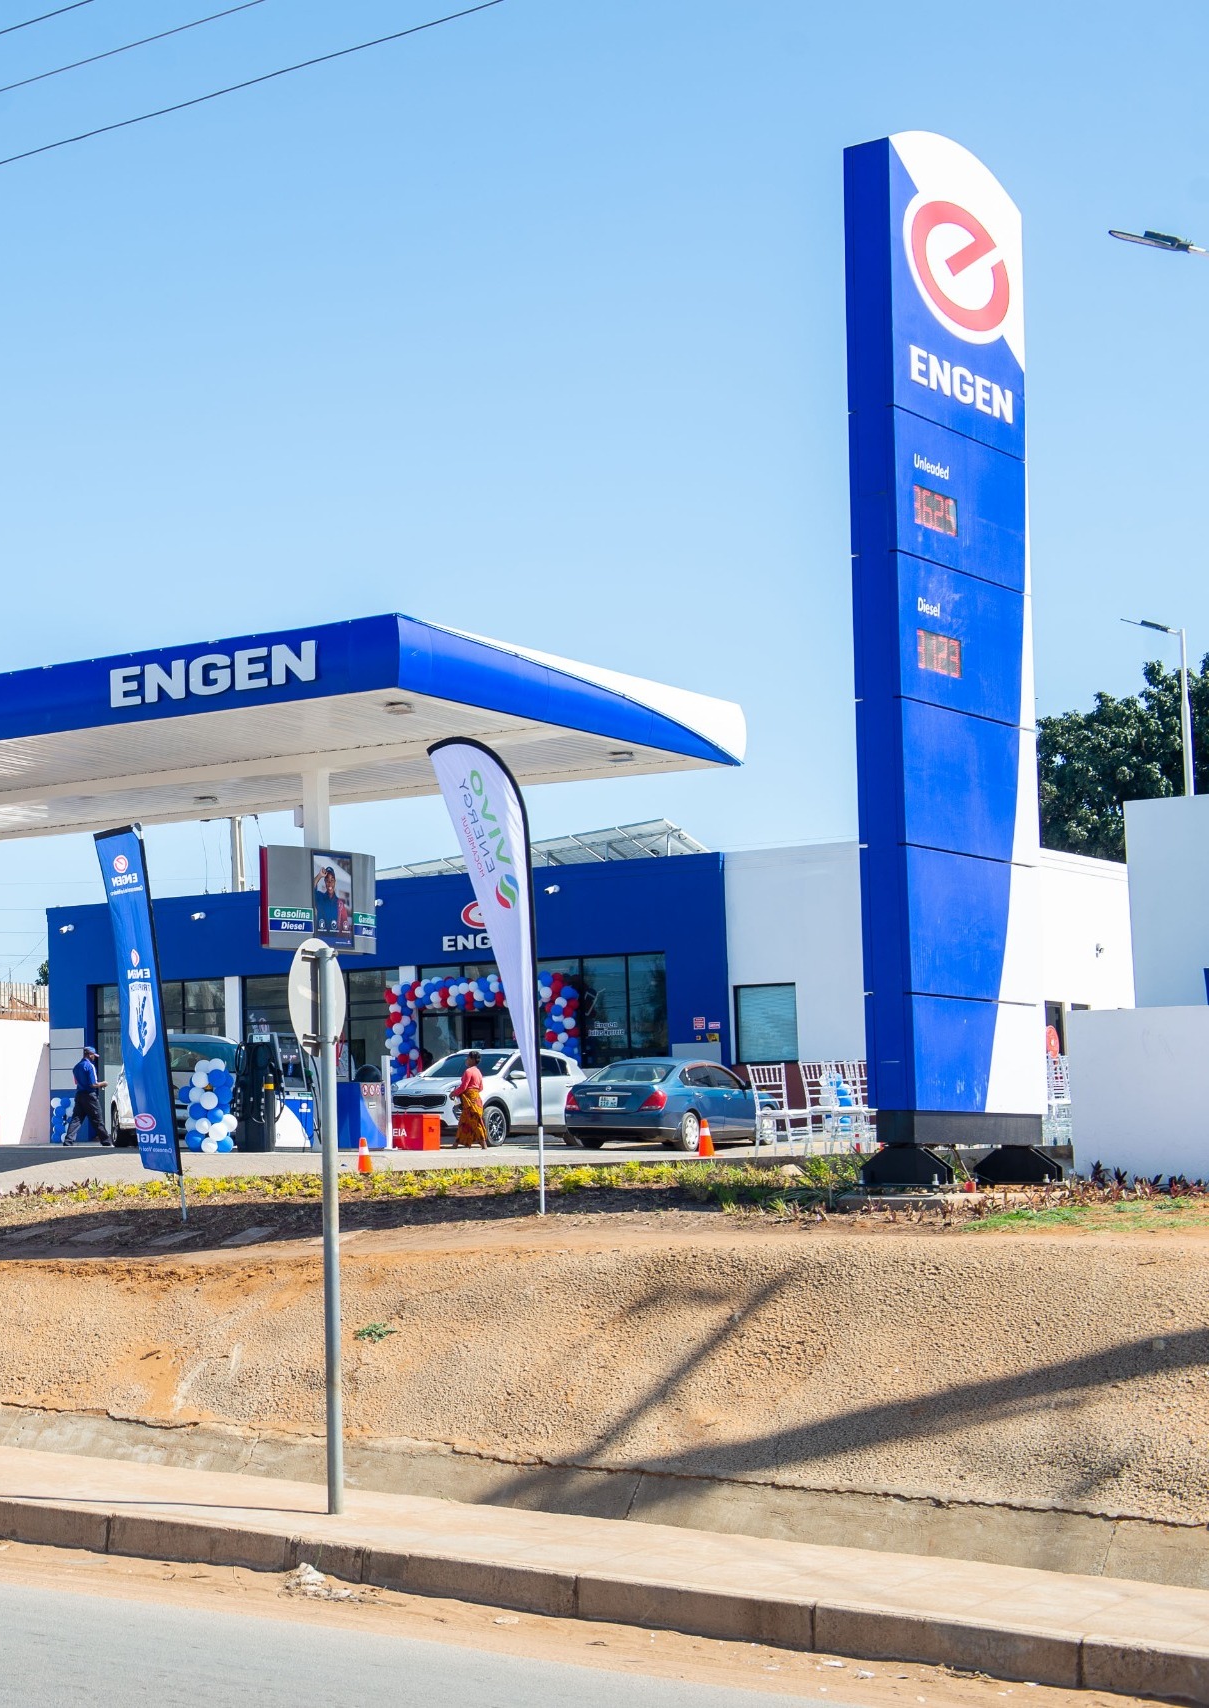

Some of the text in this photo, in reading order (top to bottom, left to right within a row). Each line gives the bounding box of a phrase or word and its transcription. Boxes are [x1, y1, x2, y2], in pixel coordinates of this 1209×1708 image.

[909, 344, 1014, 425] ENGEN
[913, 453, 949, 480] Unleaded
[917, 597, 941, 618] Diesel
[109, 640, 317, 709] ENGEN
[273, 908, 311, 920] Gasolina
[281, 921, 305, 931] Diesel
[442, 933, 492, 952] ENG
